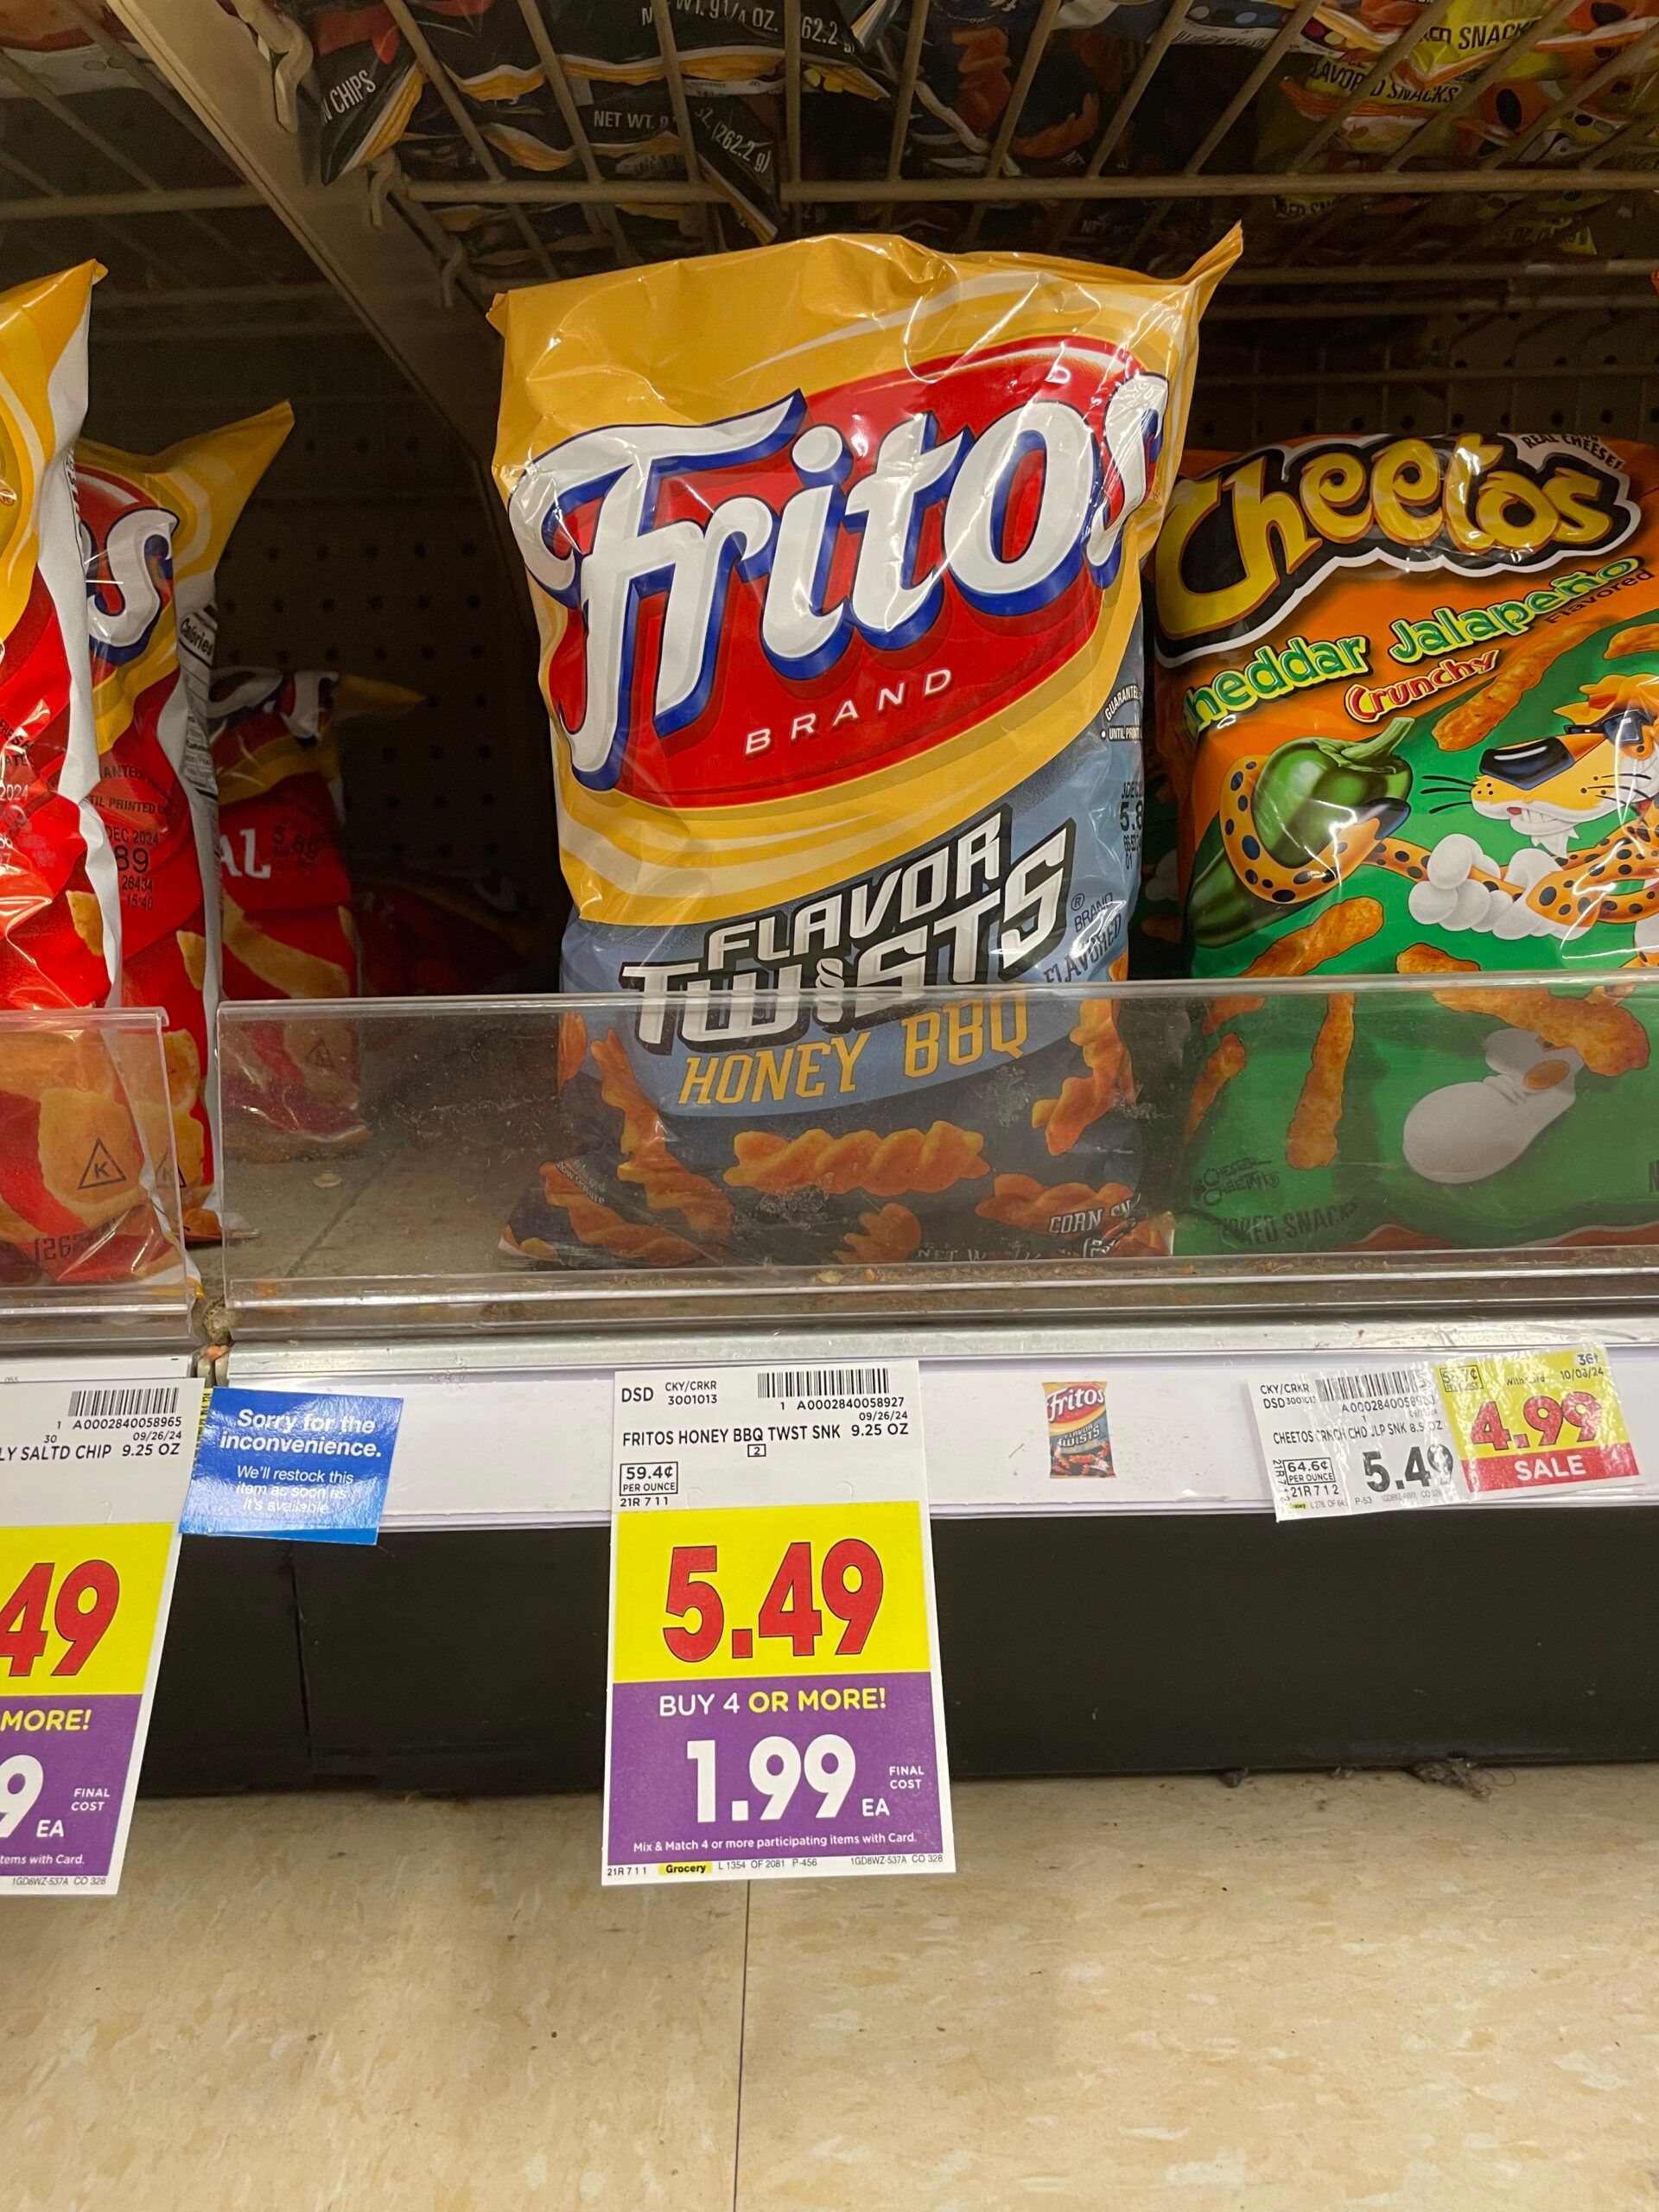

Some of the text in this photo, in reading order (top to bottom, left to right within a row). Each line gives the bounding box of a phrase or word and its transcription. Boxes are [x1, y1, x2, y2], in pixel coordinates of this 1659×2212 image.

[752, 8, 778, 33] OZ.
[329, 69, 376, 114] CHIPS
[594, 111, 655, 129] NET WT.
[1154, 434, 1614, 641] Cheetos
[508, 372, 1170, 791] Fritos
[1545, 569, 1656, 626] Flavored
[1184, 556, 1643, 743] heddar Jalapeño
[1344, 648, 1502, 724] Crunchy
[744, 664, 955, 756] BRAND
[1109, 728, 1125, 741] UNTIL
[0, 785, 29, 800] 2024
[108, 798, 156, 815] PRINTED
[1120, 800, 1143, 831] 5.8
[133, 830, 159, 845] 2024
[115, 844, 150, 874] 89
[705, 810, 1006, 971] FLAVOR
[1074, 892, 1115, 934] BRAND
[620, 825, 1070, 1047] TWISTS
[677, 981, 1027, 1106] HONEY BBQ
[1048, 1208, 1103, 1235] CORN
[1283, 1199, 1359, 1240] SNACKS
[1260, 1383, 1310, 1395] CKY/CRKR
[1505, 1375, 1525, 1386] With
[621, 1380, 718, 1403] DSD CKY/CRKR
[667, 1394, 718, 1406] 3001013
[780, 1396, 905, 1410] 1 A0002840058927
[1046, 1387, 1105, 1423] Fritos
[1263, 1397, 1286, 1409] DSD
[73, 1416, 182, 1430] A0002840058965
[237, 1408, 376, 1435] Sorry for the
[859, 1411, 908, 1421] 09/26/24
[1471, 1390, 1603, 1452] 4.99
[43, 1431, 182, 1444] 30 09/26/24
[622, 1421, 910, 1447] FRITOS HONEY BBQ TWST SNK 9.25 OZ
[1273, 1430, 1314, 1446] CHEETOS
[1348, 1426, 1368, 1440] CHD
[1370, 1424, 1386, 1438] JLP
[1389, 1422, 1408, 1435] SNK
[1409, 1422, 1425, 1433] 8.5
[1427, 1420, 1444, 1432] OZ
[21, 1442, 181, 1461] SALTD CHIP 9.25 OZ
[219, 1430, 383, 1458] inconvenience.
[753, 1446, 761, 1457] 2
[237, 1465, 355, 1484] We'll restock this
[626, 1465, 674, 1481] 59.4¢
[1287, 1460, 1329, 1472] 64.6¢
[1361, 1444, 1455, 1493] 5.49
[1513, 1453, 1588, 1482] SALE
[623, 1481, 676, 1493] PER OUNCE
[1288, 1471, 1335, 1484] PER OUNCE
[236, 1480, 347, 1500] item as soon as
[1291, 1484, 1312, 1498] 21R
[243, 1497, 264, 1510] it's
[620, 1497, 640, 1508] 21R
[1355, 1496, 1373, 1506] P-53
[662, 1537, 885, 1663] 5.49
[658, 1687, 887, 1718] BUY 4 OR MORE!
[0, 1708, 92, 1732] MORE!
[686, 1732, 857, 1824] 1.99
[888, 1764, 925, 1777] FINAL
[889, 1777, 923, 1789] COST
[73, 1788, 111, 1798] FINAL
[71, 1801, 105, 1812] COST
[862, 1797, 891, 1816] EA
[36, 1819, 65, 1838] EA
[633, 1832, 918, 1853] Mix & Match 4 or more participating items with Card.
[0, 1853, 85, 1866] tems with Card.
[726, 1860, 746, 1870] 1354
[751, 1859, 765, 1870] OF
[766, 1859, 785, 1869] 2081
[791, 1858, 818, 1868] P-456
[912, 1853, 926, 1864] CO
[927, 1853, 944, 1863] 328
[664, 1863, 707, 1876] Grocery
[73, 1876, 88, 1885] CO
[90, 1876, 107, 1885] 328
